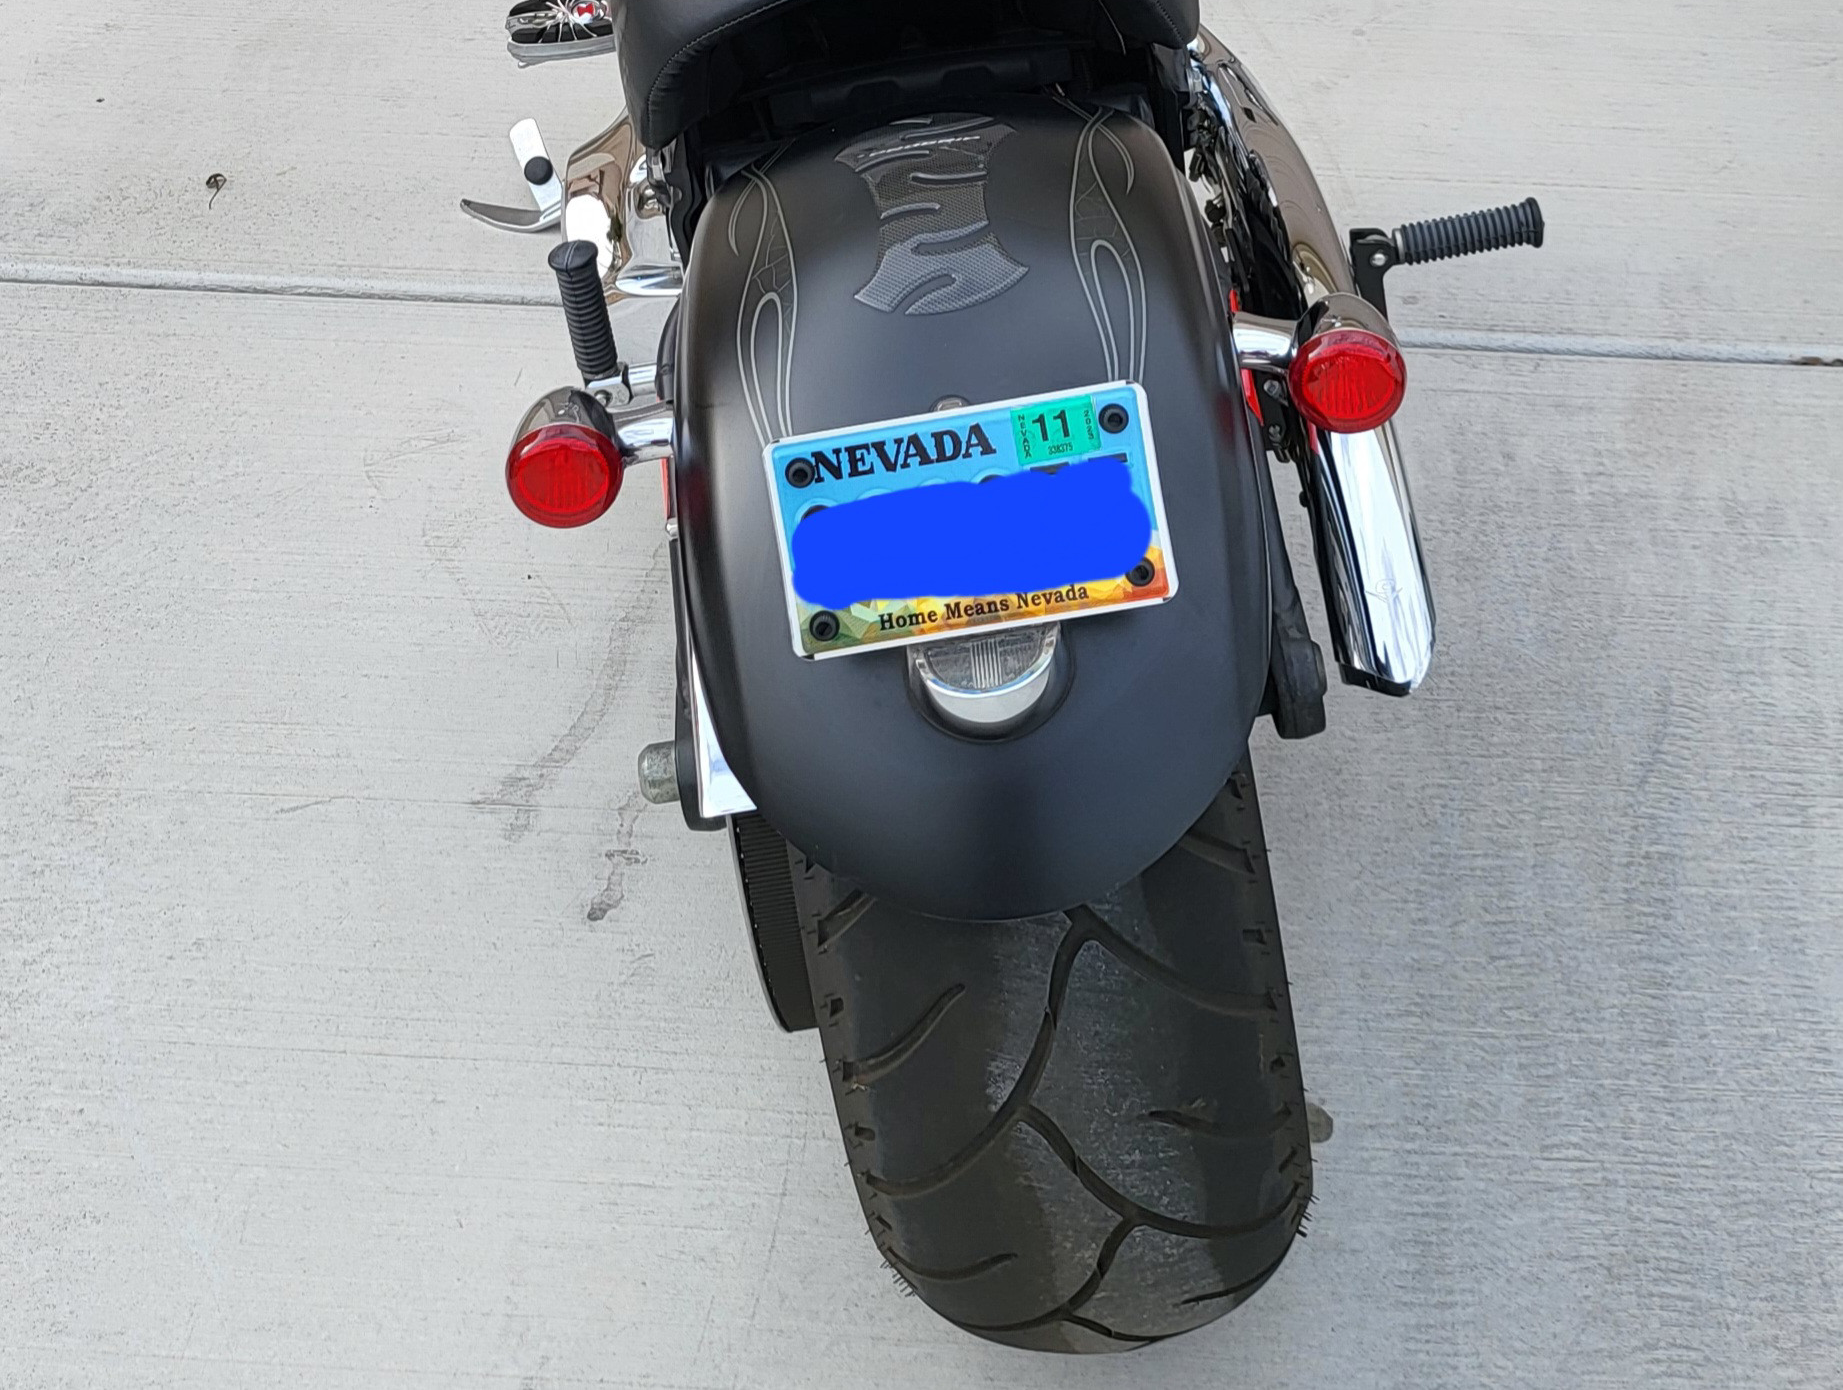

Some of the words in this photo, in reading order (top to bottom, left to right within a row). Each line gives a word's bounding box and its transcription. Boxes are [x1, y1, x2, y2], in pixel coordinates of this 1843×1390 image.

[1017, 414, 1033, 459] NEVADA
[1031, 409, 1071, 442] 11
[811, 422, 996, 483] NEVADA
[878, 610, 939, 632] Home
[943, 597, 1011, 621] Means
[1015, 584, 1090, 609] Nevada
